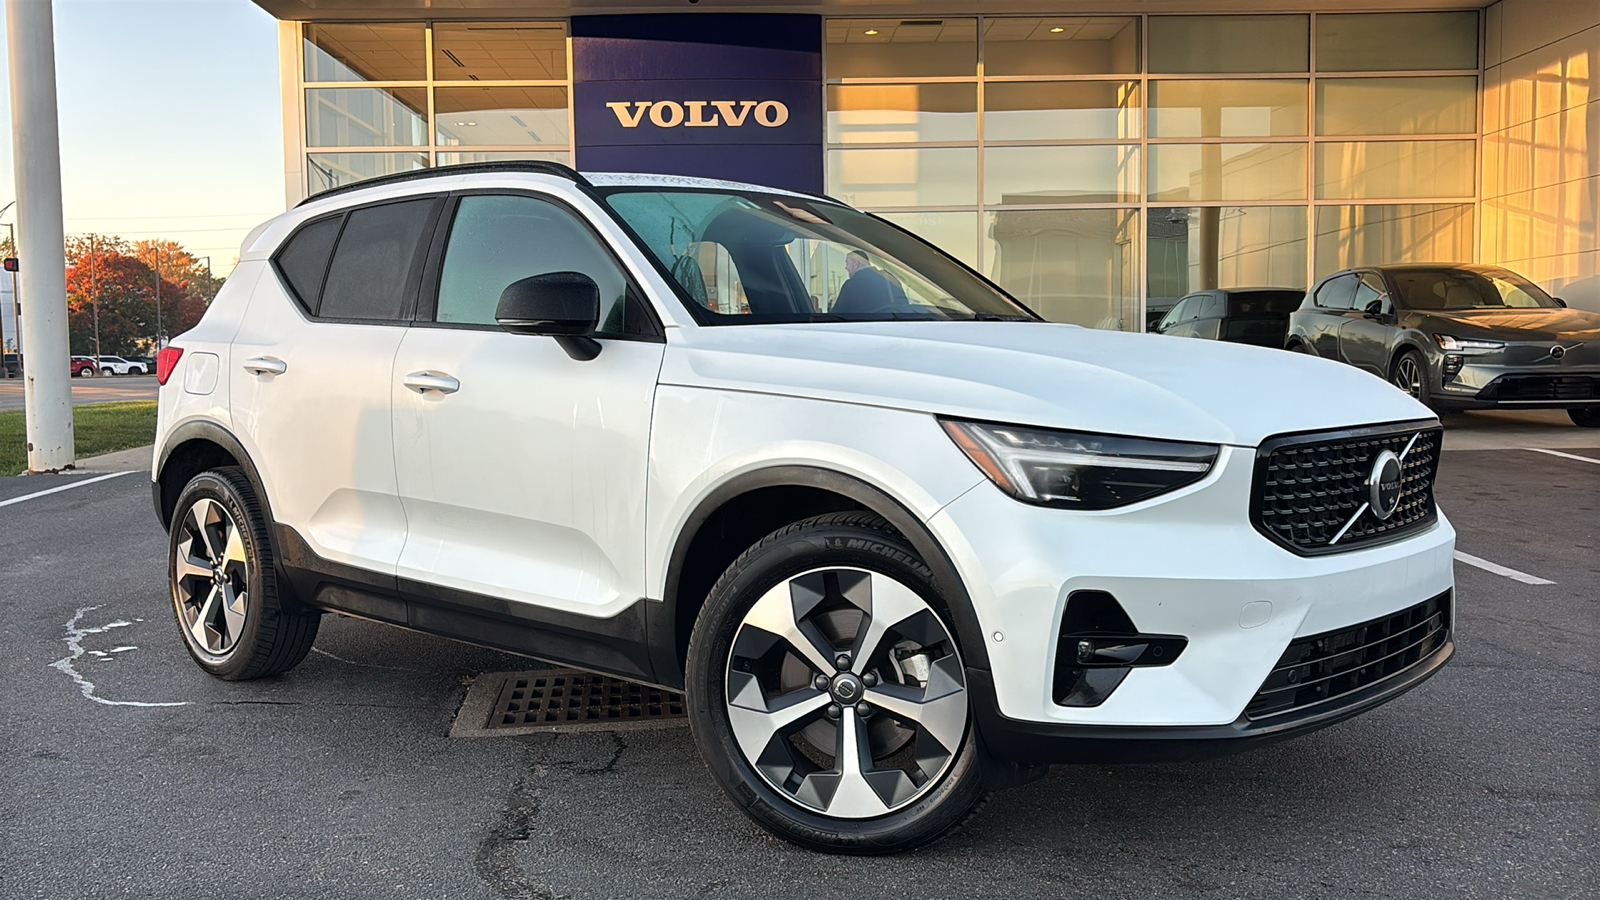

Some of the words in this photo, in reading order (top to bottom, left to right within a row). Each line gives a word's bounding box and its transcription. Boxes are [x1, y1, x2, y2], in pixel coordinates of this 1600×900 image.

[606, 100, 789, 128] VOLVO
[232, 507, 253, 559] MICHELIN
[846, 538, 933, 578] MICHELIN
